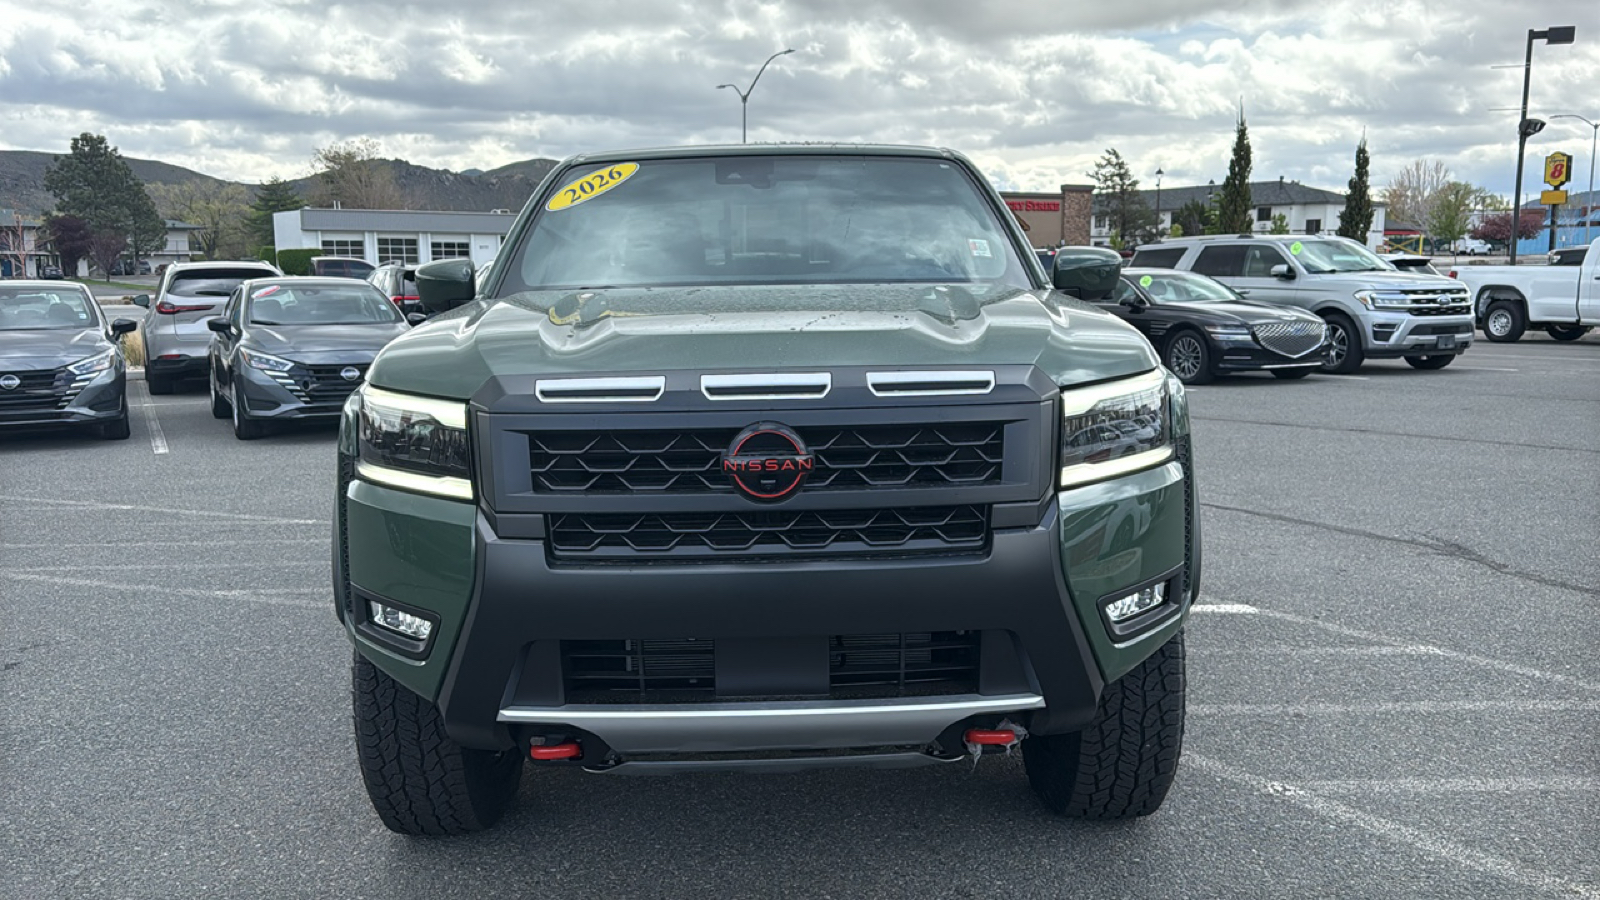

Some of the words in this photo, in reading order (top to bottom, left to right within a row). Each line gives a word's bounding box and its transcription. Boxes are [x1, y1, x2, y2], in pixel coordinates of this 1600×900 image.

[1551, 164, 1565, 179] 8
[564, 166, 622, 204] 2026
[723, 458, 812, 472] NISSAN
